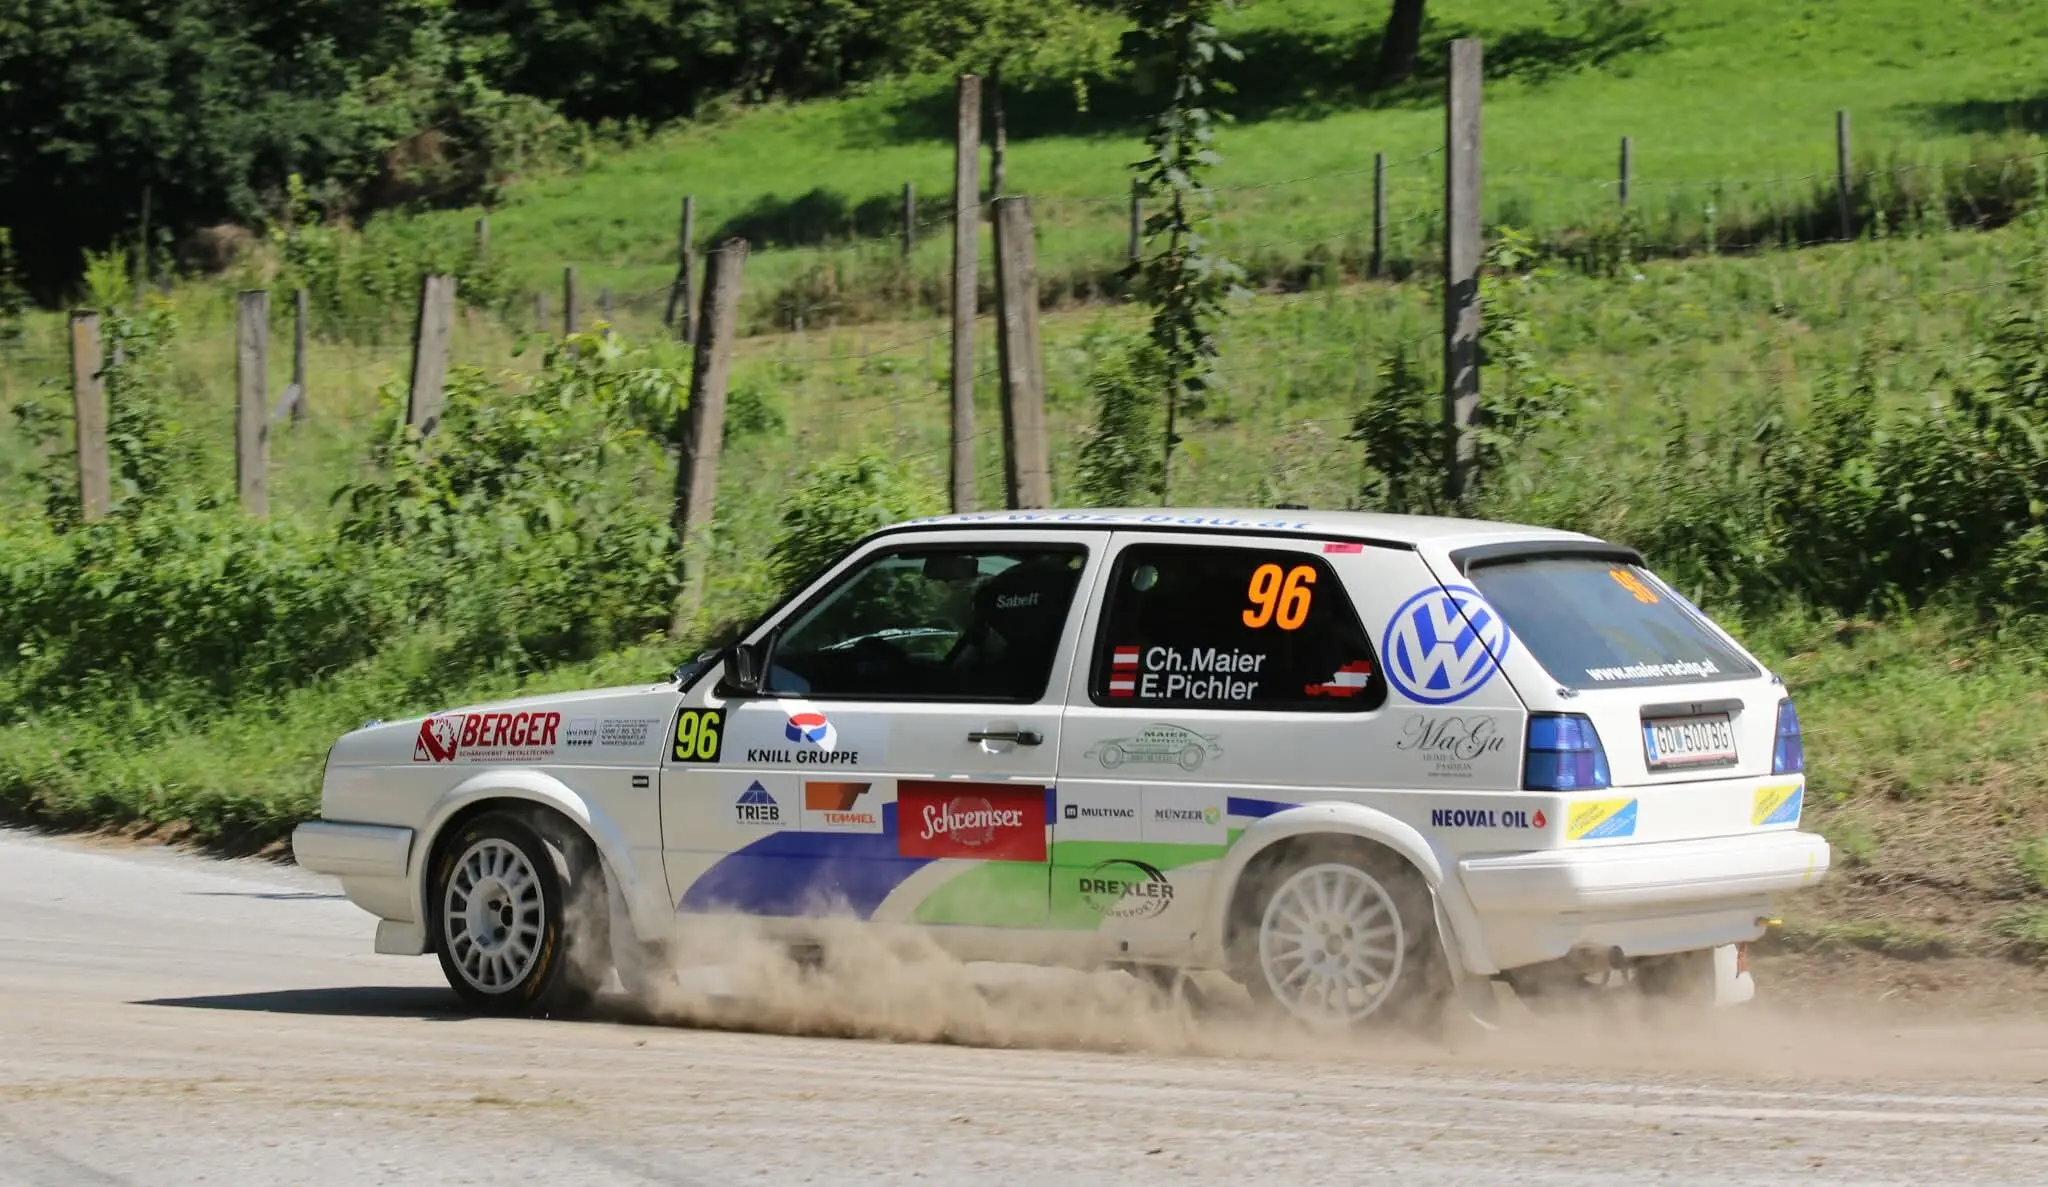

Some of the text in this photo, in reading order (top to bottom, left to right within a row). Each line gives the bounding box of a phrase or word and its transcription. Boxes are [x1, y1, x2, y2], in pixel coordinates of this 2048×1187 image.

[1242, 563, 1317, 631] 96
[1145, 645, 1266, 674] Ch.Maier
[1585, 659, 1720, 681] www.maier-racing.at
[1140, 673, 1260, 700] E.Pichler
[461, 711, 561, 747] BERGER
[675, 710, 721, 760] 96
[1682, 722, 1711, 751] 600
[1711, 721, 1729, 748] BG
[747, 749, 859, 765] KNILL GRUPPE
[735, 805, 780, 821] TRIEB
[920, 801, 1023, 840] Schremser
[1081, 807, 1134, 818] MULTIVAC
[1154, 808, 1203, 820] MÜNZER
[1431, 809, 1529, 829] NEOVAL OIL
[1079, 878, 1174, 899] DREXLER
